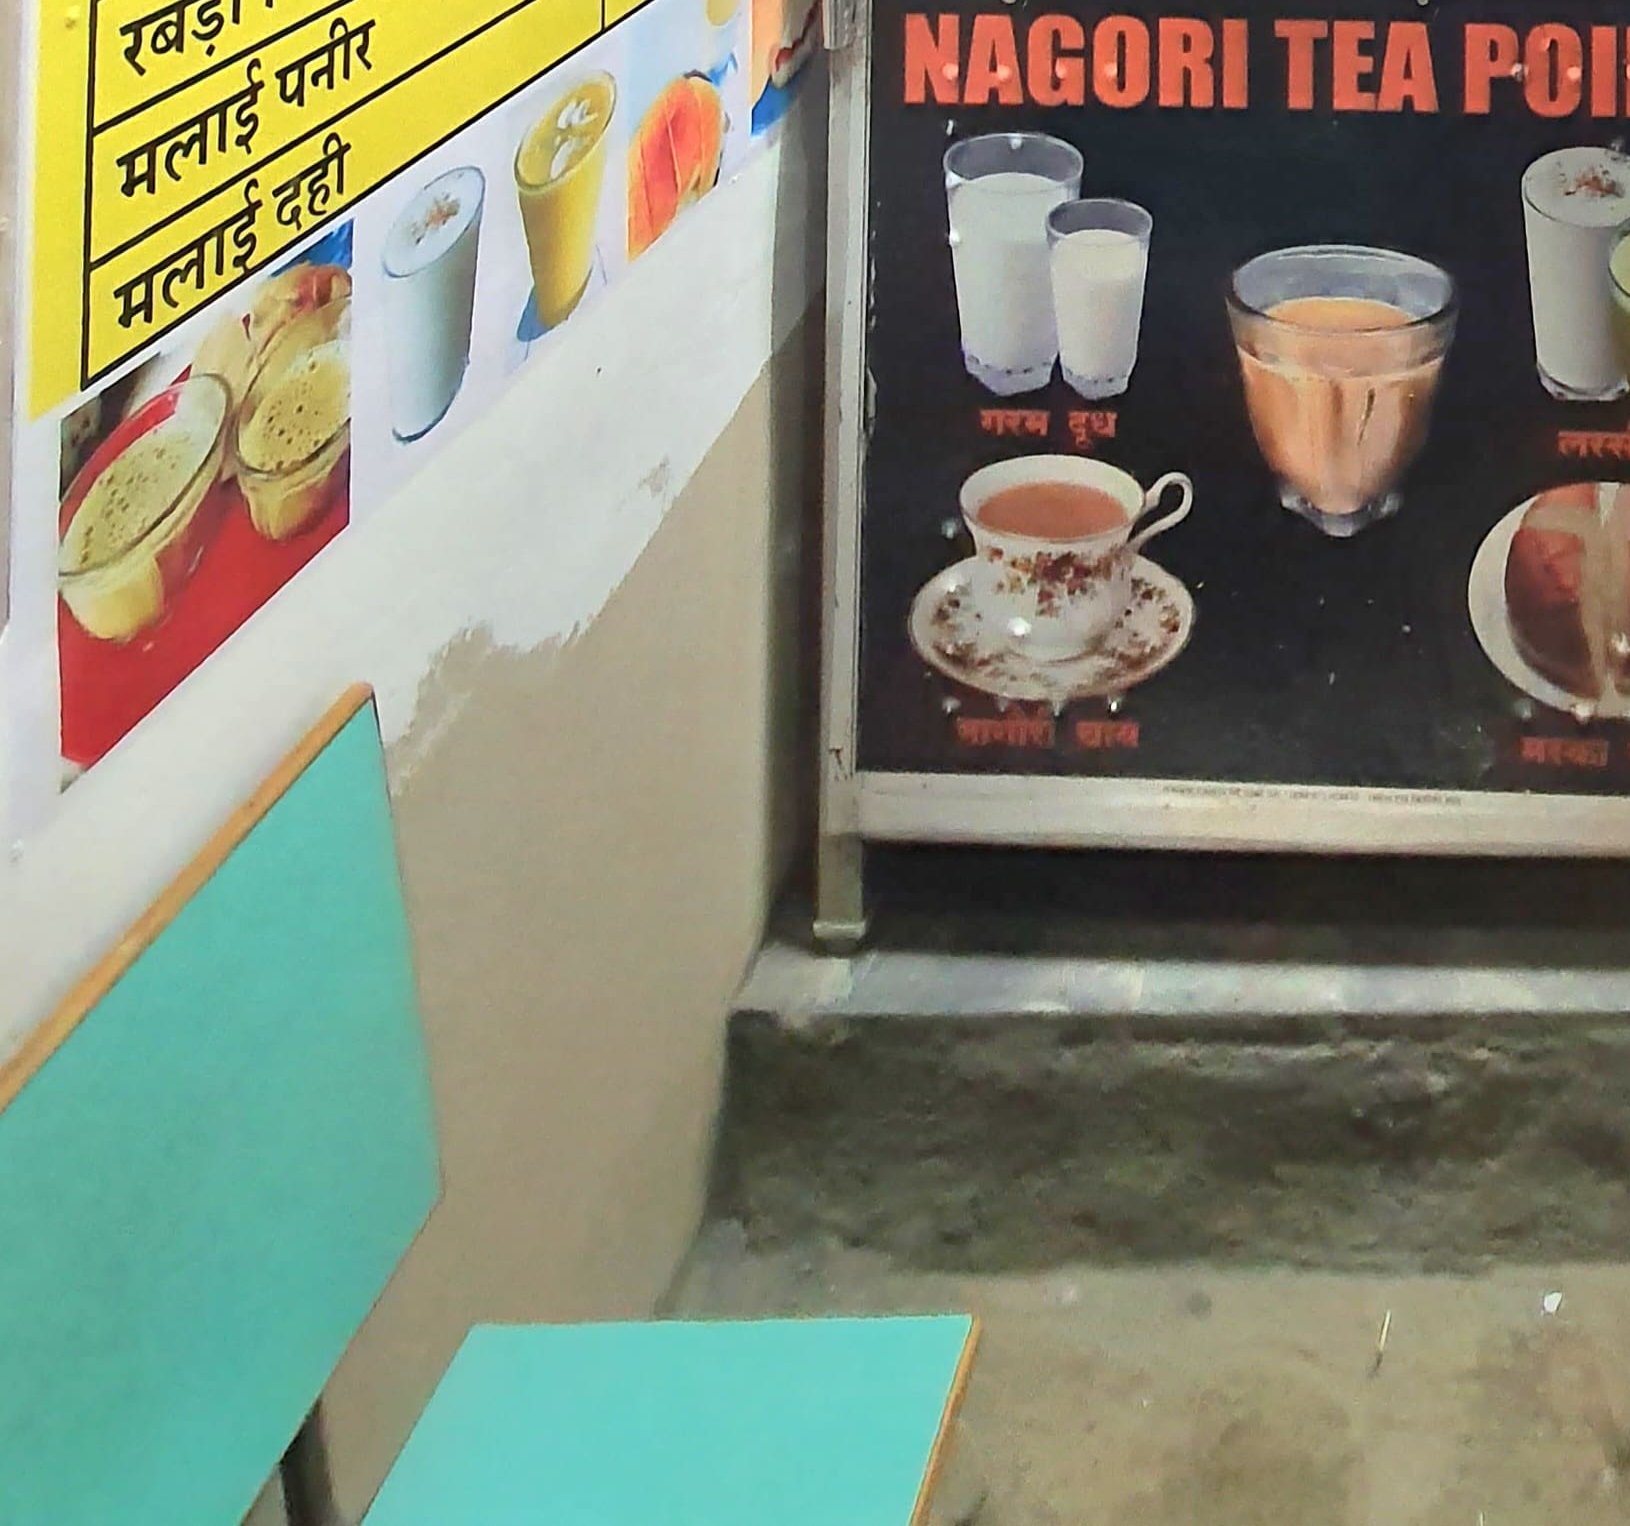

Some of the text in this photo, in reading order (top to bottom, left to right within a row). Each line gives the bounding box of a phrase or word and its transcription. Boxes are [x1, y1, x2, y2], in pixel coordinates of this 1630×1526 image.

[116, 57, 265, 199] मलाई
[275, 16, 378, 108] पनीर
[903, 11, 1250, 111] NAGORI
[1273, 18, 1440, 114] TEA
[113, 179, 264, 329] मलाई
[272, 132, 353, 231] दही
